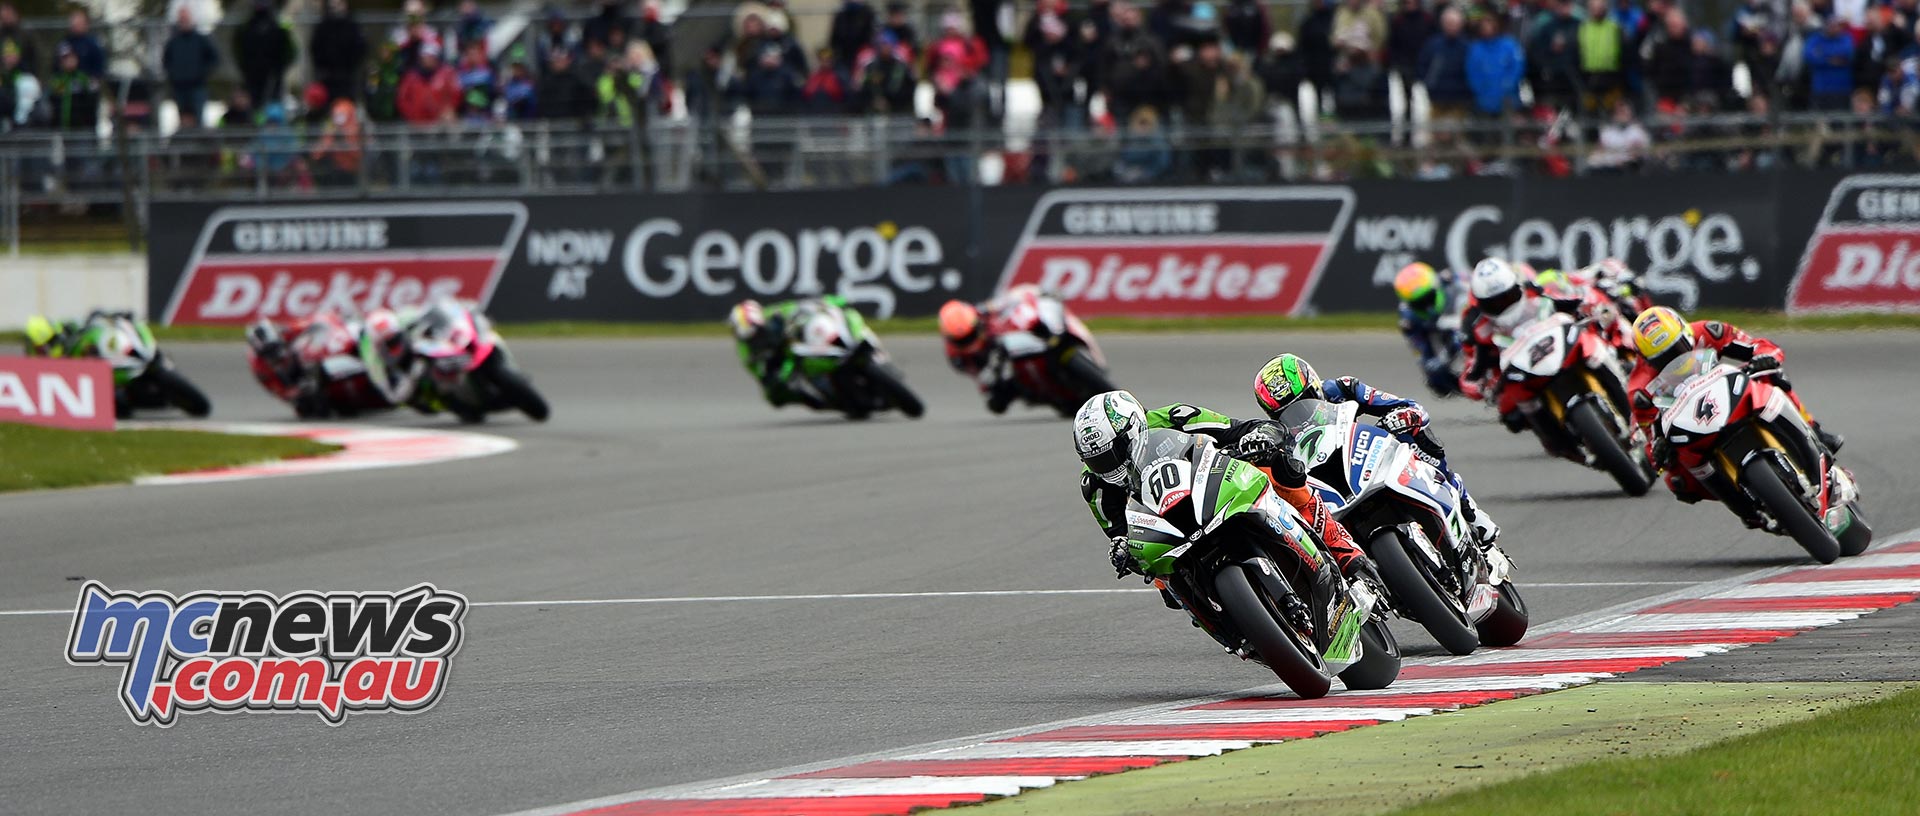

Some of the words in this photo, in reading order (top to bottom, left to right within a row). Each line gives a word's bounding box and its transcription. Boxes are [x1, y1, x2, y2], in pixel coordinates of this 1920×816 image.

[232, 219, 389, 251] GENUINE
[1062, 203, 1219, 234] GENUINE
[1354, 216, 1437, 251] NOW
[527, 230, 614, 266] NOW
[199, 268, 463, 318] Dickies
[548, 265, 592, 299] AT
[1040, 253, 1290, 300] Dickies
[1694, 391, 1719, 424] 4
[1083, 431, 1101, 443] SHOEI
[1300, 428, 1324, 463] 7
[1351, 430, 1371, 466] tyco
[1367, 439, 1384, 469] OXFORD
[1409, 443, 1441, 467] OXFORD
[1148, 462, 1181, 506] 60
